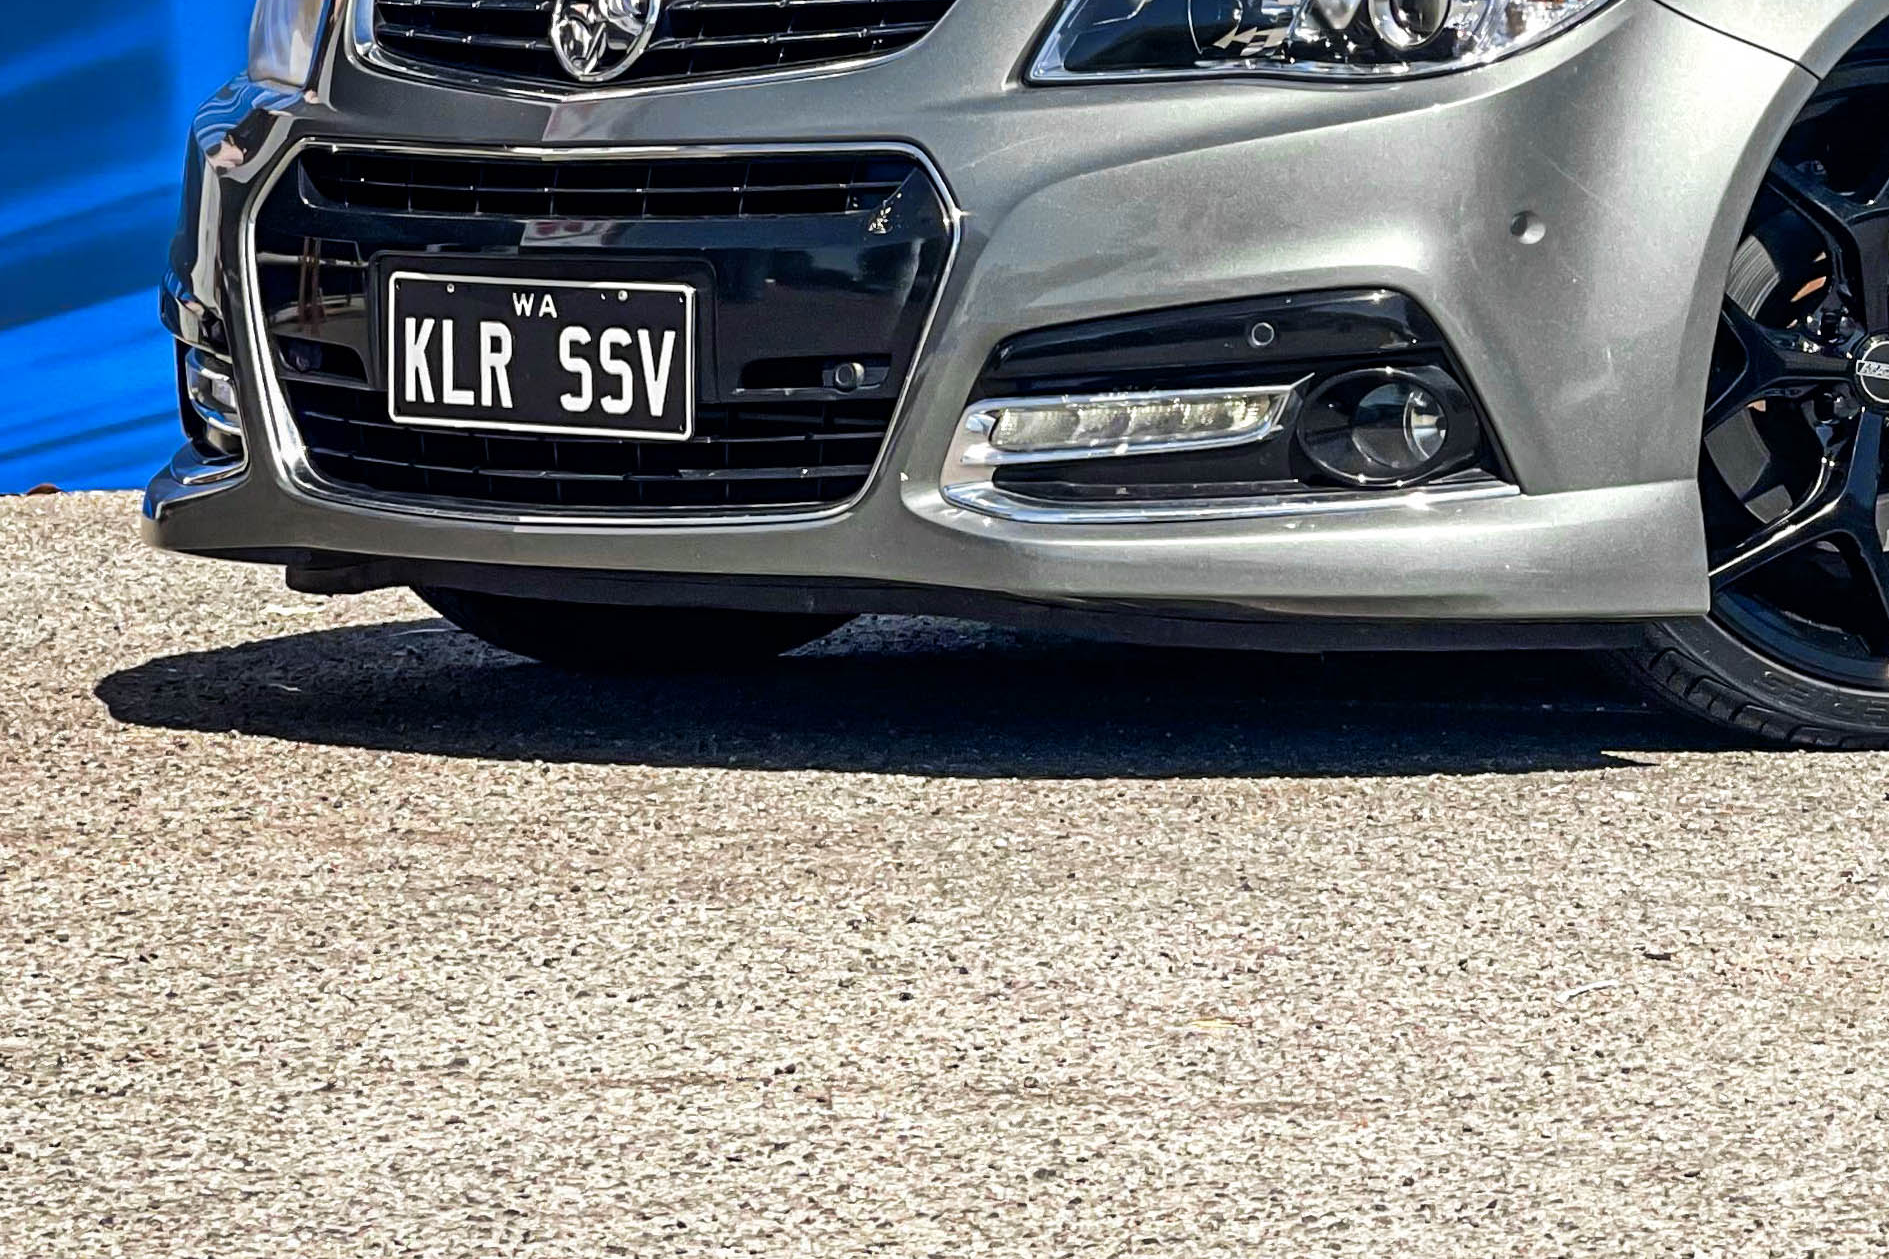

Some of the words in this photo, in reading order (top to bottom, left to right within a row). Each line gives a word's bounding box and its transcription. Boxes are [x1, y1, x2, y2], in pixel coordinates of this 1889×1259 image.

[512, 291, 558, 319] WA
[404, 316, 513, 409] KLR
[558, 325, 677, 418] SSV
